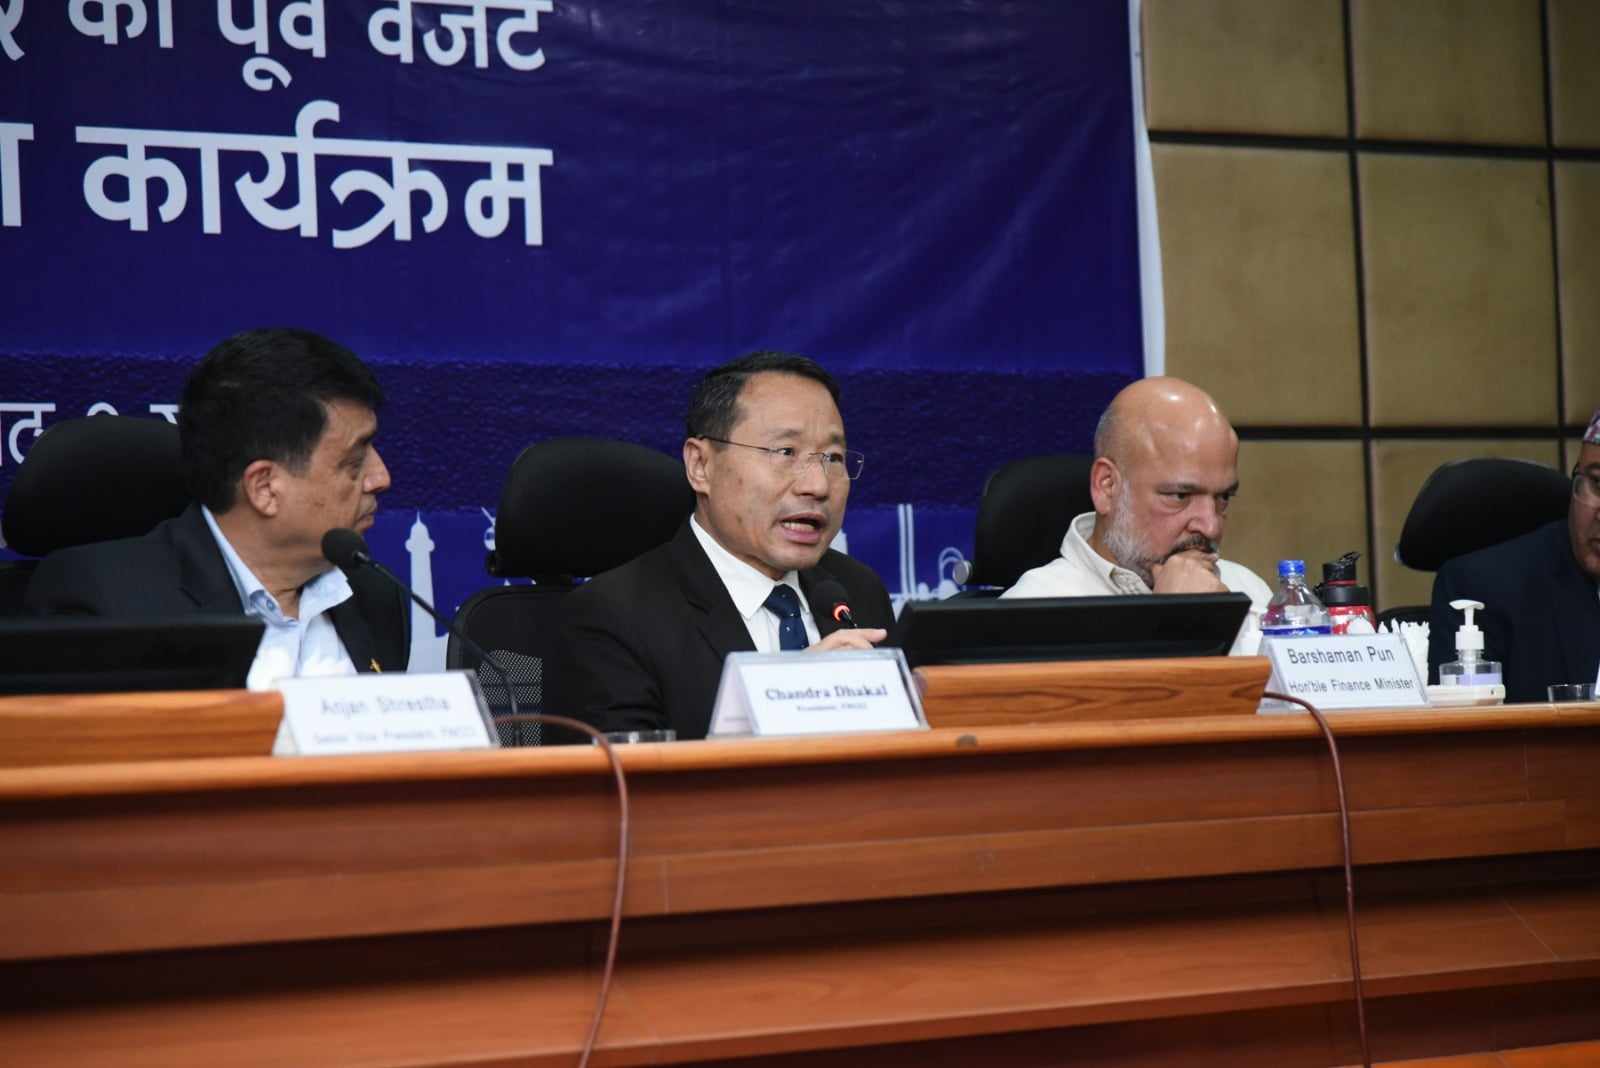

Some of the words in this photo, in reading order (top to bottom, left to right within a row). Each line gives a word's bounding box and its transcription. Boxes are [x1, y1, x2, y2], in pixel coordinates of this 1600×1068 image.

[76, 100, 553, 248] कार्यक्रम
[1287, 647, 1363, 664] Barshaman
[1366, 645, 1395, 662] Pun
[764, 687, 832, 701] Chandra
[833, 683, 888, 697] Dhakal
[1331, 677, 1372, 691] Finance
[1374, 677, 1416, 690] Minister
